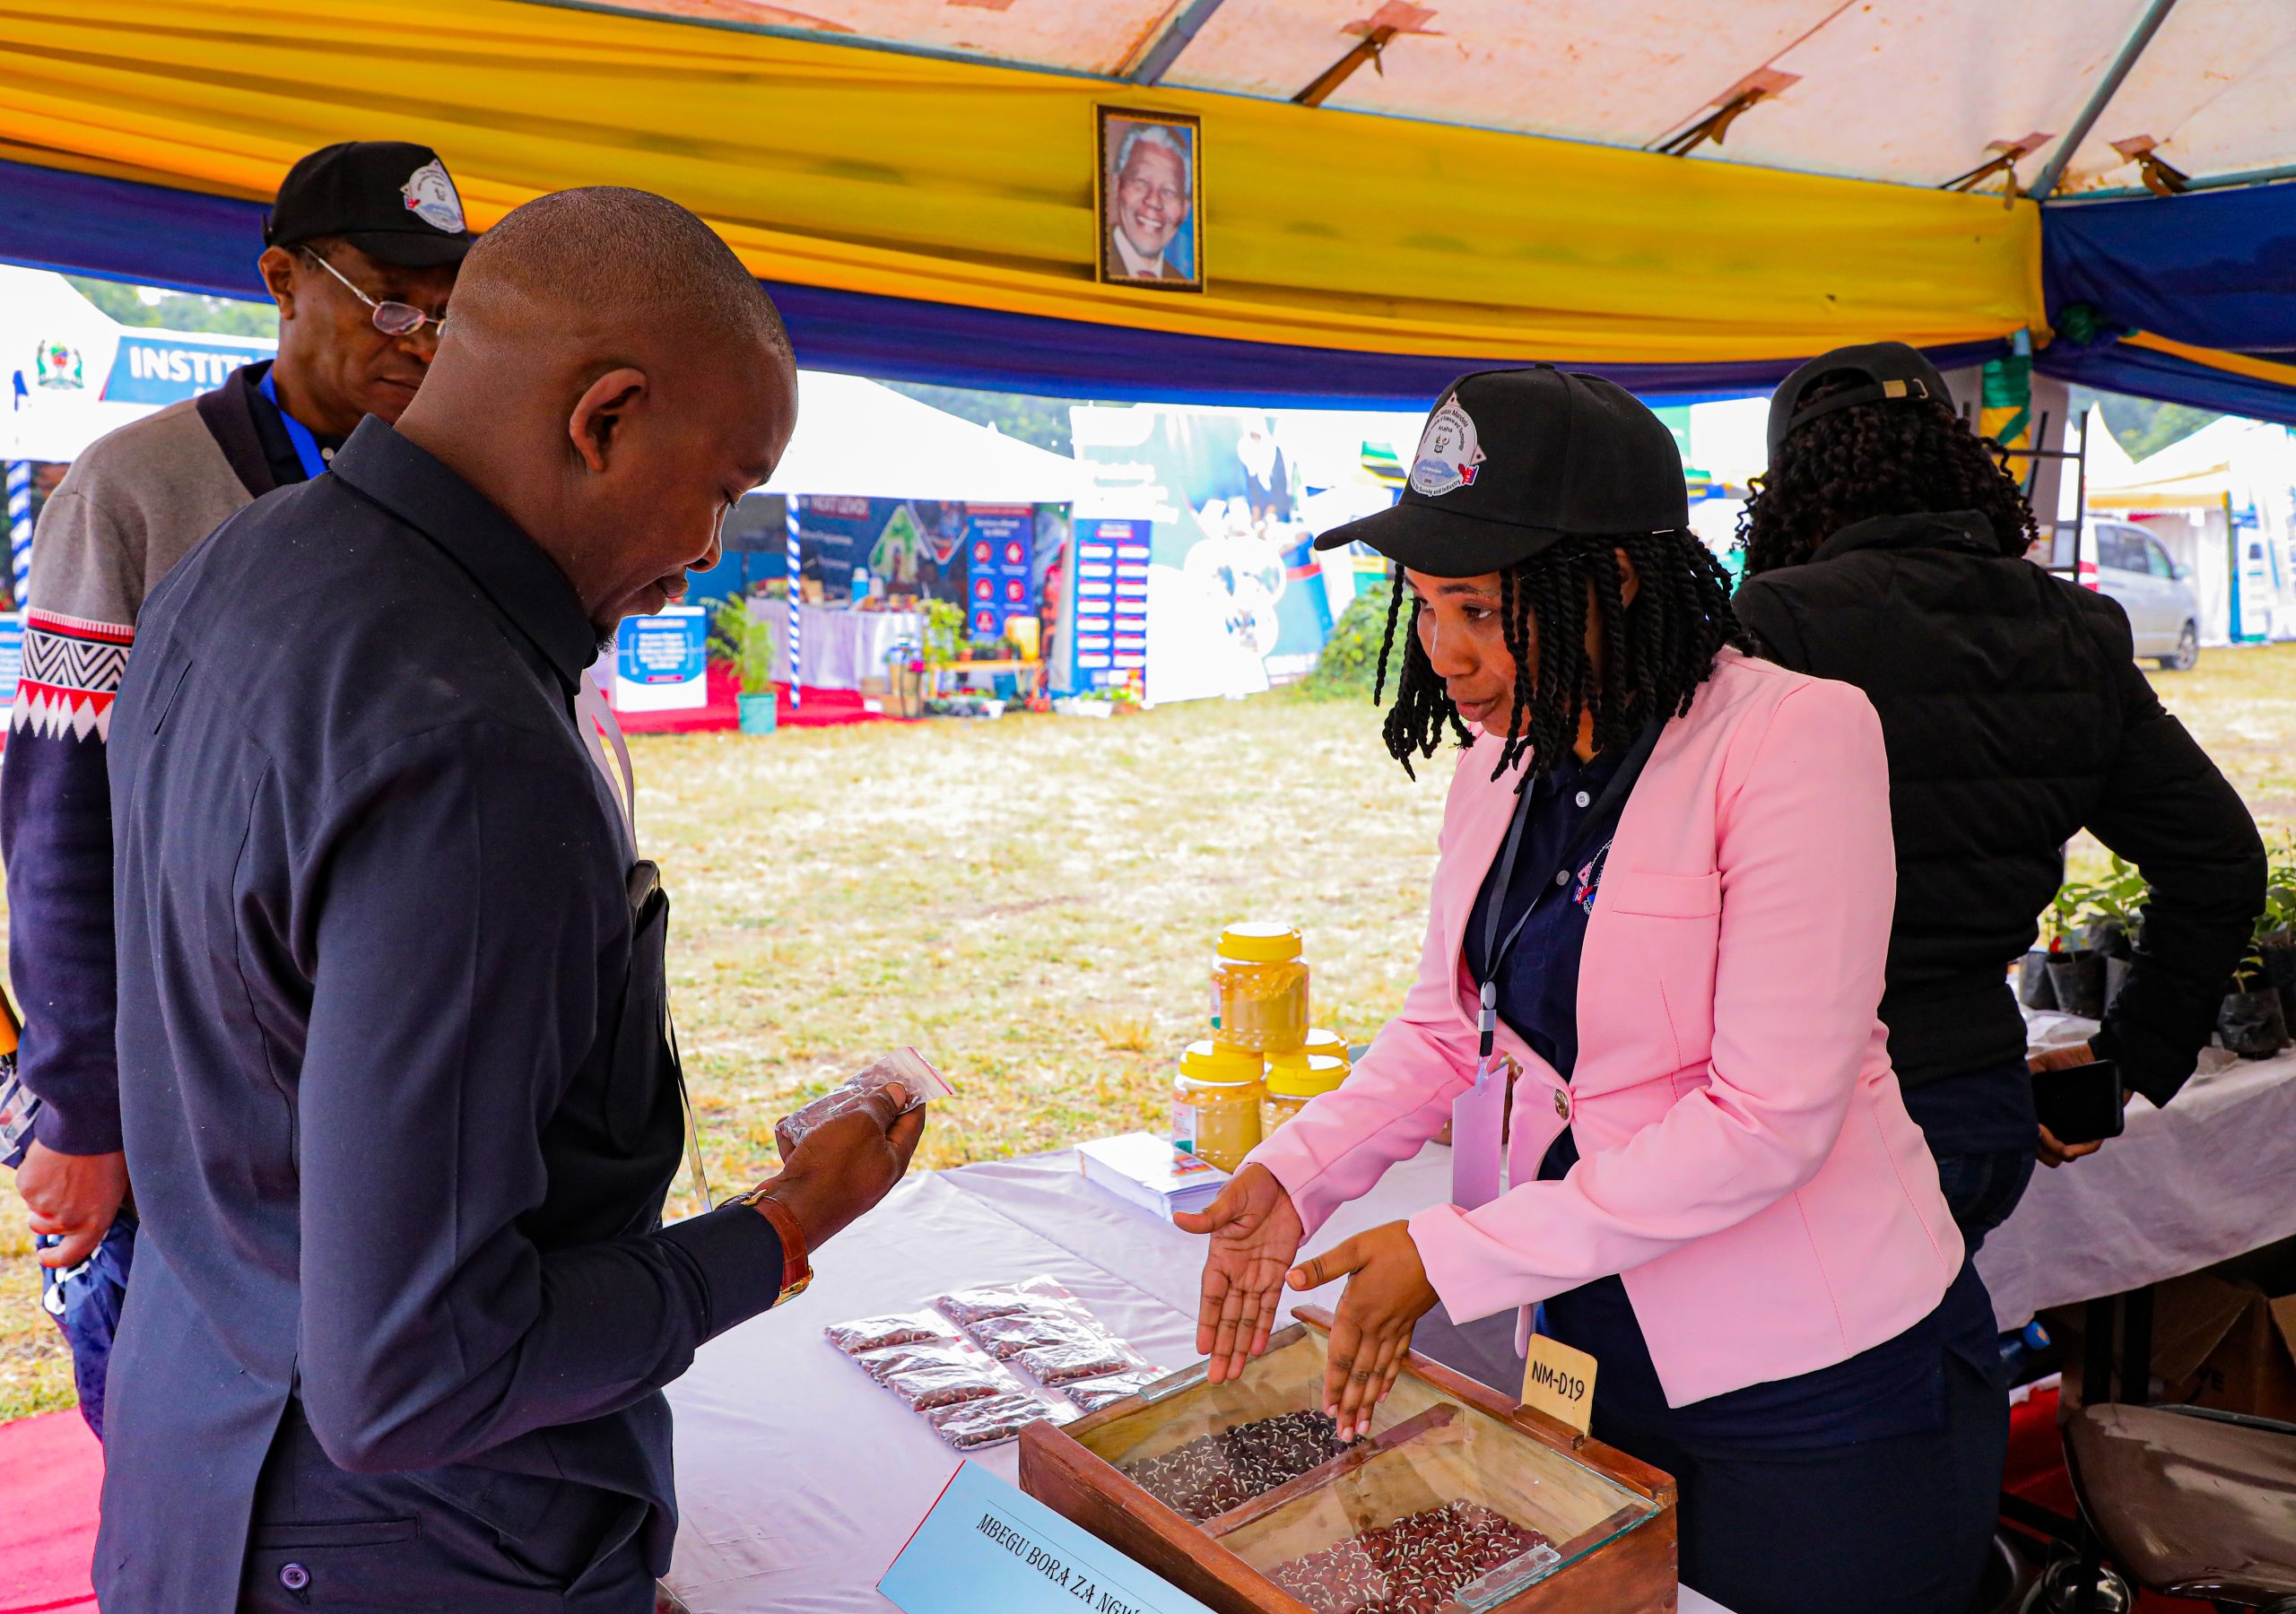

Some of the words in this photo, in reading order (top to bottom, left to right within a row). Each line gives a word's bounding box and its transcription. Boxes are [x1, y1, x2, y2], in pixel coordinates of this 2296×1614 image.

[130, 346, 264, 385] INSTIT
[1532, 1360, 1585, 1401] NM-D19
[976, 1513, 1031, 1557] MBEGU
[1025, 1546, 1071, 1588] BORA
[1069, 1575, 1096, 1604] ZA
